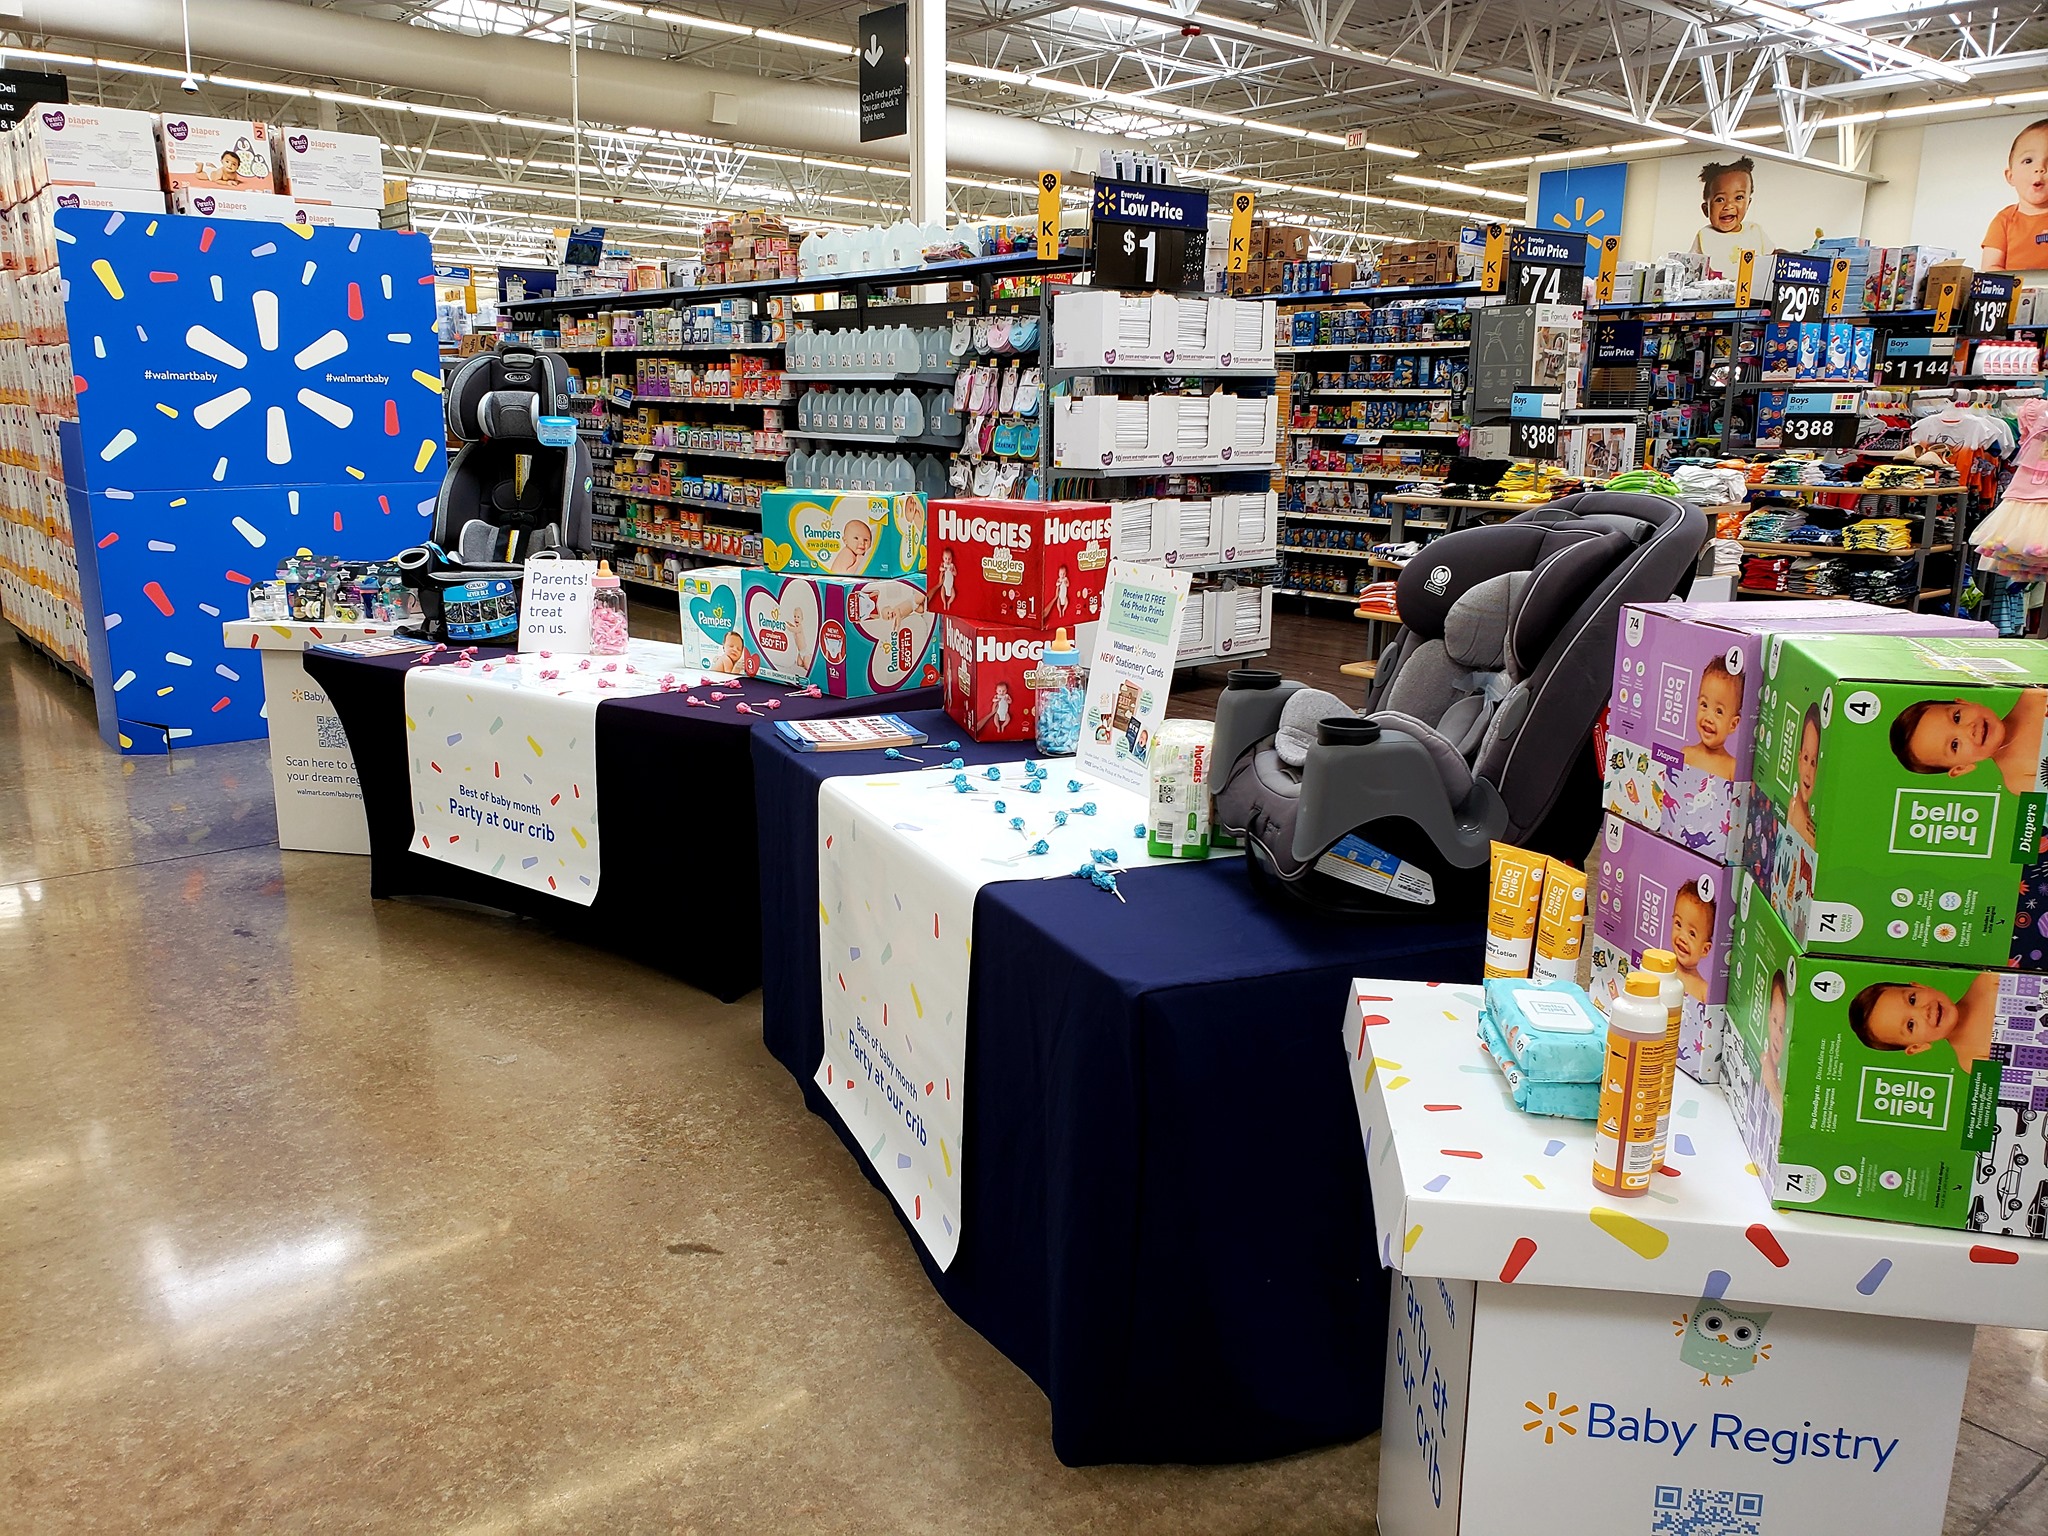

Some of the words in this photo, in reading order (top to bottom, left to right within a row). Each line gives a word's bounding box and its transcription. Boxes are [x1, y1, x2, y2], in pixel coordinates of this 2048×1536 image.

[875, 89, 884, 99] find
[888, 85, 903, 98] price?
[880, 99, 894, 109] check
[256, 130, 263, 139] 2
[1348, 132, 1362, 147] EXIT
[172, 181, 179, 189] 2
[1120, 190, 1145, 201] Everyday
[1120, 202, 1149, 216] Low
[1150, 202, 1183, 220] Price
[1042, 221, 1053, 236] K
[1233, 238, 1244, 251] K
[1527, 244, 1545, 256] Low
[1546, 245, 1569, 258] Price
[1123, 229, 1156, 282] $1
[1234, 257, 1241, 270] 2
[1486, 261, 1496, 273] K
[1601, 272, 1611, 282] K
[1787, 267, 1801, 278] Low
[1801, 267, 1818, 280] Price
[1486, 278, 1494, 288] 3
[1521, 265, 1561, 304] $74
[1740, 282, 1748, 292] K
[1981, 284, 1992, 294] Low
[1992, 285, 2005, 295] Price
[1600, 286, 1608, 297] 4
[1832, 289, 1840, 299] K
[1740, 296, 1746, 305] 5
[1831, 302, 1838, 312] 6
[1938, 311, 1947, 321] K
[1937, 323, 1944, 331] 7
[1616, 348, 1635, 356] Price
[144, 370, 218, 383] #walmartbaby
[325, 373, 390, 385] #walmartbaby
[1513, 395, 1527, 405] Boys
[1790, 396, 1809, 405] Boys
[1521, 424, 1556, 449] $388
[1785, 419, 1834, 440] $388
[803, 525, 841, 540] Pampers
[938, 509, 1032, 549] HUGGIES
[1044, 517, 1111, 546] HUGGIES
[807, 541, 840, 549] swaddlers
[773, 551, 778, 560] 1
[789, 559, 799, 567] 96
[1078, 550, 1107, 562] snugglers
[982, 558, 1024, 573] snugglers
[467, 581, 488, 589] GRACO
[532, 572, 588, 587] Parents!
[531, 589, 565, 601] Have
[569, 593, 577, 601] a
[1123, 588, 1144, 600] Receive
[1144, 593, 1150, 602] 12
[1151, 594, 1167, 605] FREE
[529, 606, 563, 618] treat
[1016, 600, 1027, 609] 96
[1028, 596, 1036, 613] 1
[1120, 600, 1131, 609] 4x6
[1131, 602, 1148, 613] Photo
[1148, 605, 1165, 616] Prints
[698, 611, 732, 628] Pampers
[759, 612, 787, 631] Pampers
[1629, 616, 1640, 629] 74
[528, 624, 545, 634] on
[549, 623, 567, 634] us.
[775, 640, 787, 650] FIT
[887, 631, 898, 672] Pampers
[946, 626, 973, 664] HUGGIES
[1113, 640, 1135, 653] Walmart
[1141, 648, 1157, 659] Photo
[748, 658, 753, 669] 3
[1100, 652, 1115, 663] NEW
[1115, 656, 1146, 675] Stationery
[1146, 664, 1164, 678] Cards
[1729, 650, 1738, 667] 4
[304, 691, 326, 704] Baby
[1662, 677, 1674, 723] hello
[1672, 679, 1686, 725] bello
[1823, 693, 1830, 714] 4
[1850, 701, 1871, 716] 4
[286, 756, 309, 767] Scan
[311, 758, 335, 768] here
[336, 759, 348, 769] to
[1656, 749, 1680, 764] Diapers
[1193, 745, 1205, 784] HUGGIES
[287, 773, 309, 784] your
[311, 772, 343, 783] dream
[459, 784, 478, 799] Best
[480, 791, 489, 801] of
[491, 792, 511, 811] baby
[513, 801, 541, 816] month
[449, 797, 483, 826] Party
[486, 811, 499, 827] at
[502, 817, 525, 833] our
[528, 823, 555, 842] crib
[1910, 801, 1979, 824] bello
[1609, 823, 1619, 838] 74
[1909, 824, 1978, 846] hello
[2019, 803, 2037, 853] Diapers
[1498, 868, 1512, 896] hello
[1507, 870, 1522, 898] bello
[1701, 878, 1710, 895] 4
[1545, 886, 1559, 914] hello
[1551, 887, 1566, 916] bello
[1640, 889, 1652, 935] hello
[1650, 893, 1661, 937] bello
[1819, 913, 1838, 933] 74
[1839, 913, 1847, 932] DIAPER
[1497, 947, 1518, 958] Lotion
[1538, 968, 1557, 979] Lotion
[1813, 980, 1831, 993] 4
[856, 1016, 871, 1045] Best
[871, 1037, 879, 1052] of
[879, 1042, 895, 1075] baby
[895, 1068, 918, 1102] month
[849, 1028, 873, 1081] Party
[874, 1067, 885, 1092] at
[886, 1085, 904, 1115] our
[905, 1109, 927, 1147] crib
[1874, 1077, 1936, 1098] bello
[1874, 1098, 1934, 1120] hello
[1967, 1117, 1975, 1139] Serious
[1972, 1072, 1982, 1103] Protection
[1786, 1173, 1803, 1193] 74
[1804, 1174, 1812, 1195] DIAPERS
[1810, 1173, 1818, 1196] COUCHES
[1396, 1327, 1415, 1406] our
[1432, 1366, 1449, 1438] at
[1586, 1402, 1698, 1457] Baby
[1709, 1412, 1900, 1473] Registry
[1416, 1403, 1442, 1509] crib
